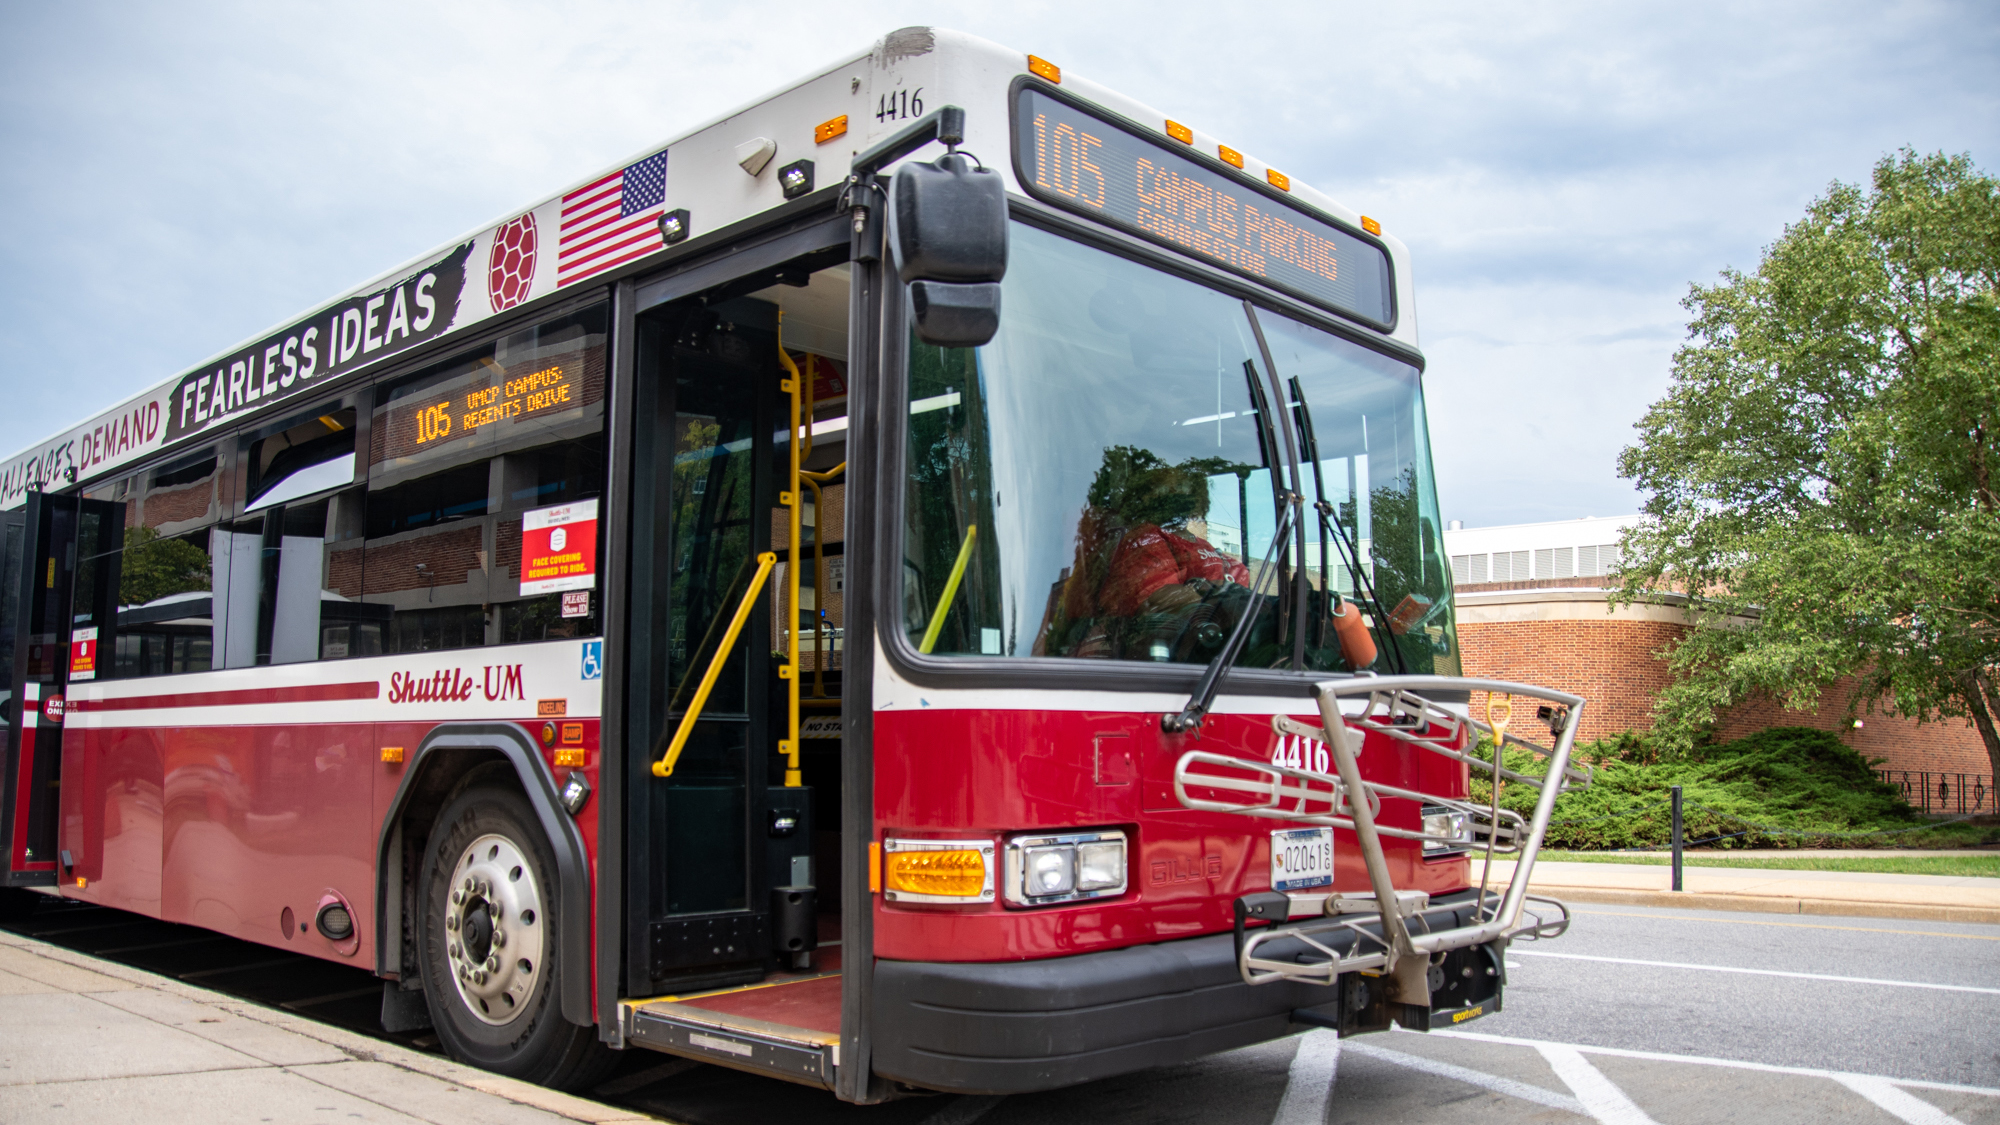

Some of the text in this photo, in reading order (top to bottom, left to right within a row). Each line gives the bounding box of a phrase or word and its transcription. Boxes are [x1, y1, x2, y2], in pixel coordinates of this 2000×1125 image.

[876, 87, 924, 123] 4416
[1032, 113, 1105, 209] 105
[1136, 157, 1338, 281] CAMPUS PARKING
[1136, 207, 1267, 277] CONNECTOR
[0, 272, 437, 505] ALLENGES DEMAND FEARLESS IDEAS
[467, 366, 563, 410] UMCP CAMPUS:
[416, 401, 452, 444] 105
[463, 384, 571, 431] REGENTS DRIVE
[528, 562, 587, 579] REQUIRED TO RIDE.
[532, 552, 582, 568] FACE COVERING
[563, 603, 587, 614] Show ID
[564, 593, 587, 605] PLEASE
[388, 663, 526, 704] Shuttle-UM
[46, 707, 64, 715] ONL
[48, 700, 64, 708] EXI
[539, 701, 566, 714] KNEELING
[564, 727, 581, 739] RAMP
[806, 722, 842, 732] NO STA
[1271, 735, 1329, 775] 4416
[1151, 856, 1221, 886] GILLIG
[1285, 843, 1322, 873] 02061
[1453, 1006, 1482, 1023] sportworks
